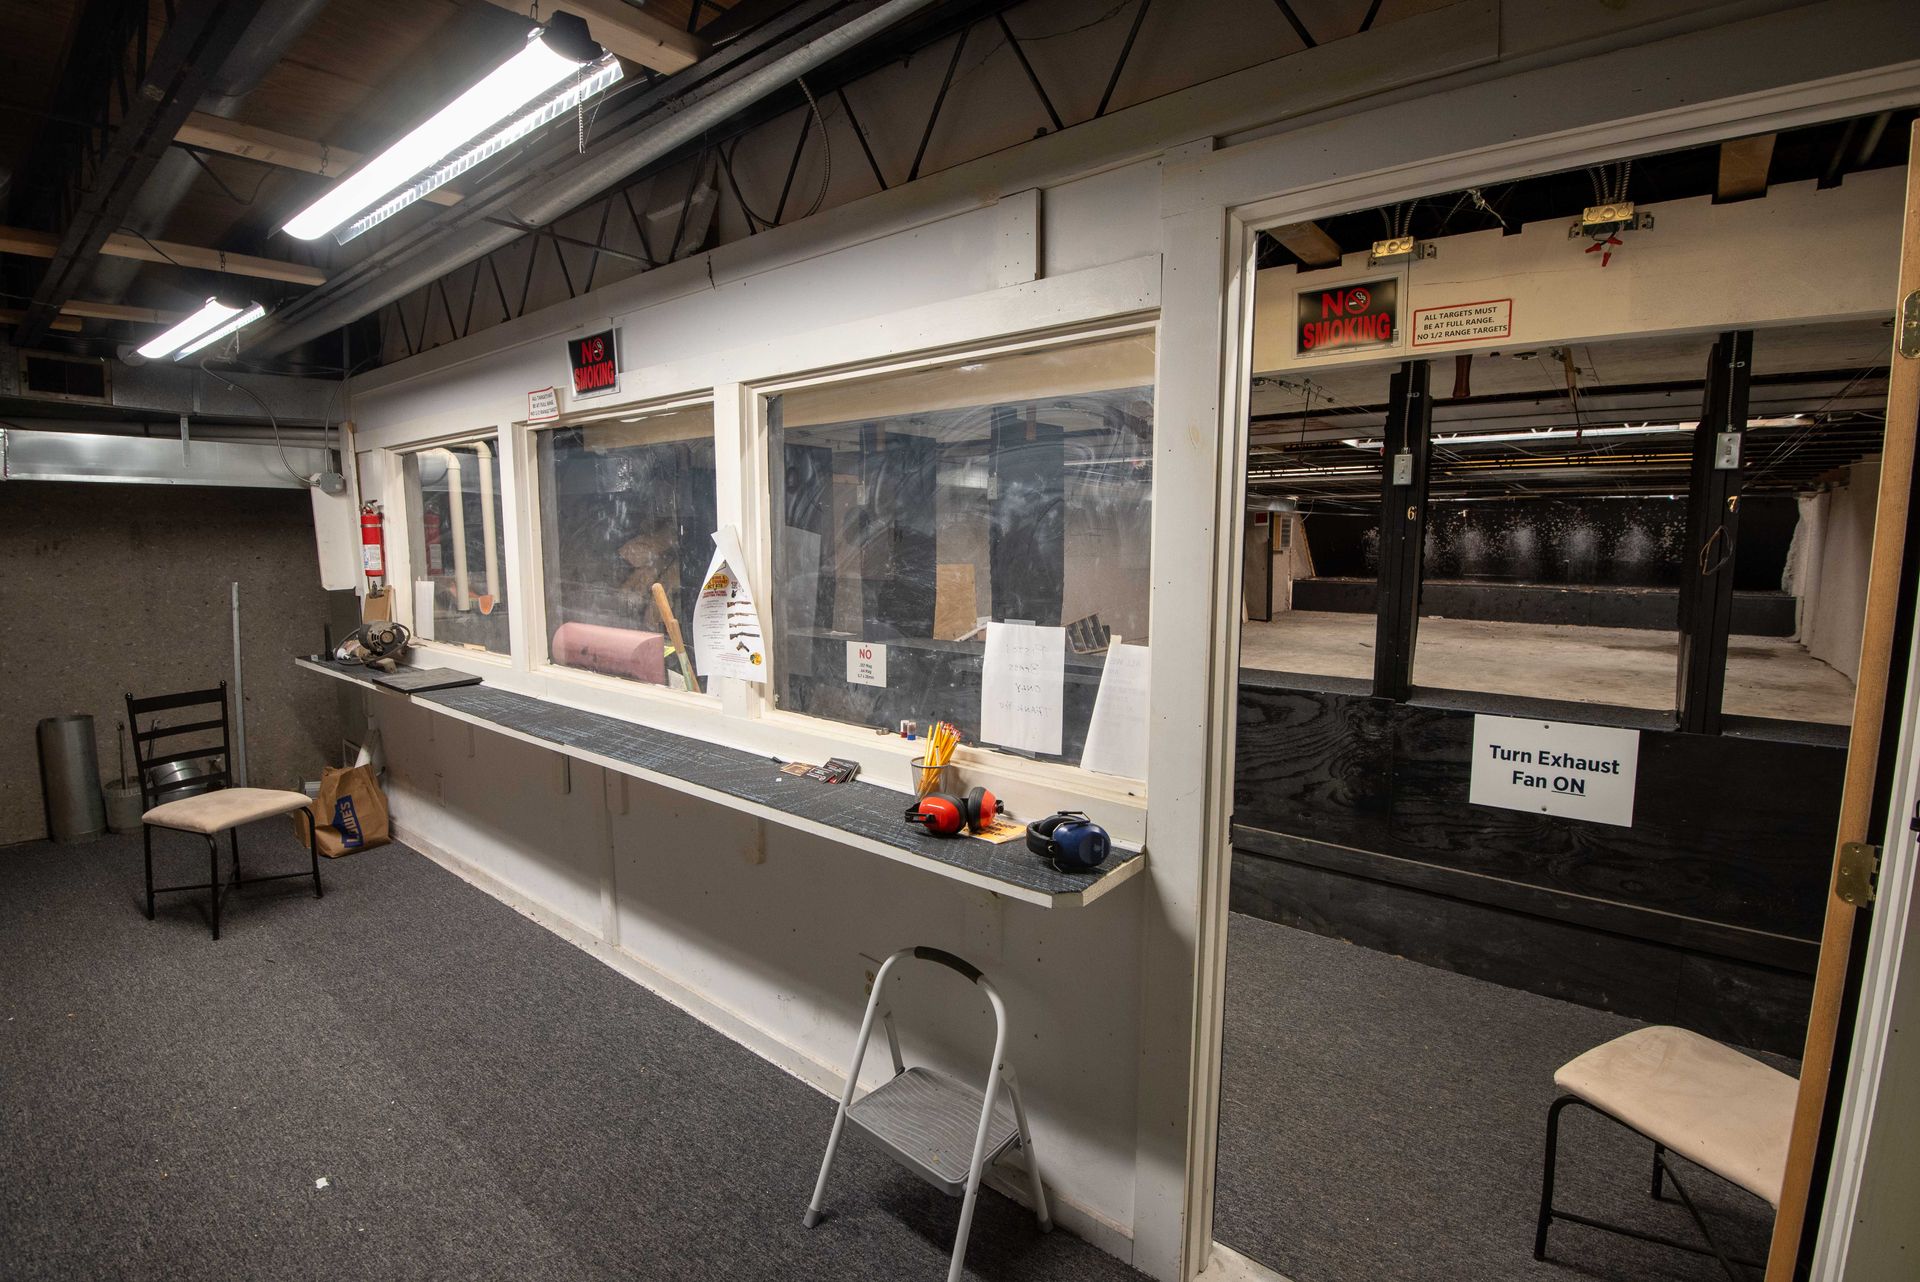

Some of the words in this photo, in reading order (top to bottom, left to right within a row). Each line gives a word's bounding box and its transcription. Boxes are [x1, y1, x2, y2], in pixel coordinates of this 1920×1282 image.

[1321, 287, 1371, 319] NO
[1424, 313, 1438, 321] ALL
[1439, 309, 1473, 320] TARGETS
[1475, 306, 1498, 316] MUST
[1303, 312, 1391, 350] SMOKING
[1417, 333, 1429, 341] NO
[1431, 331, 1442, 339] 1/2
[1444, 328, 1471, 338] RANGE
[1473, 324, 1507, 336] TARGETS
[1423, 323, 1433, 331] BE
[1434, 321, 1444, 329] AT
[1446, 320, 1464, 328] FULL
[1466, 316, 1495, 327] RANGE.
[581, 338, 604, 364] NO
[574, 359, 614, 392] SMOKING
[1407, 505, 1416, 521] 6
[1727, 495, 1738, 513] 7
[859, 648, 872, 660] NO
[1489, 744, 1532, 764] Turn
[1538, 750, 1620, 775] Exhaust
[1512, 770, 1547, 789] Fan
[1553, 776, 1585, 796] ON
